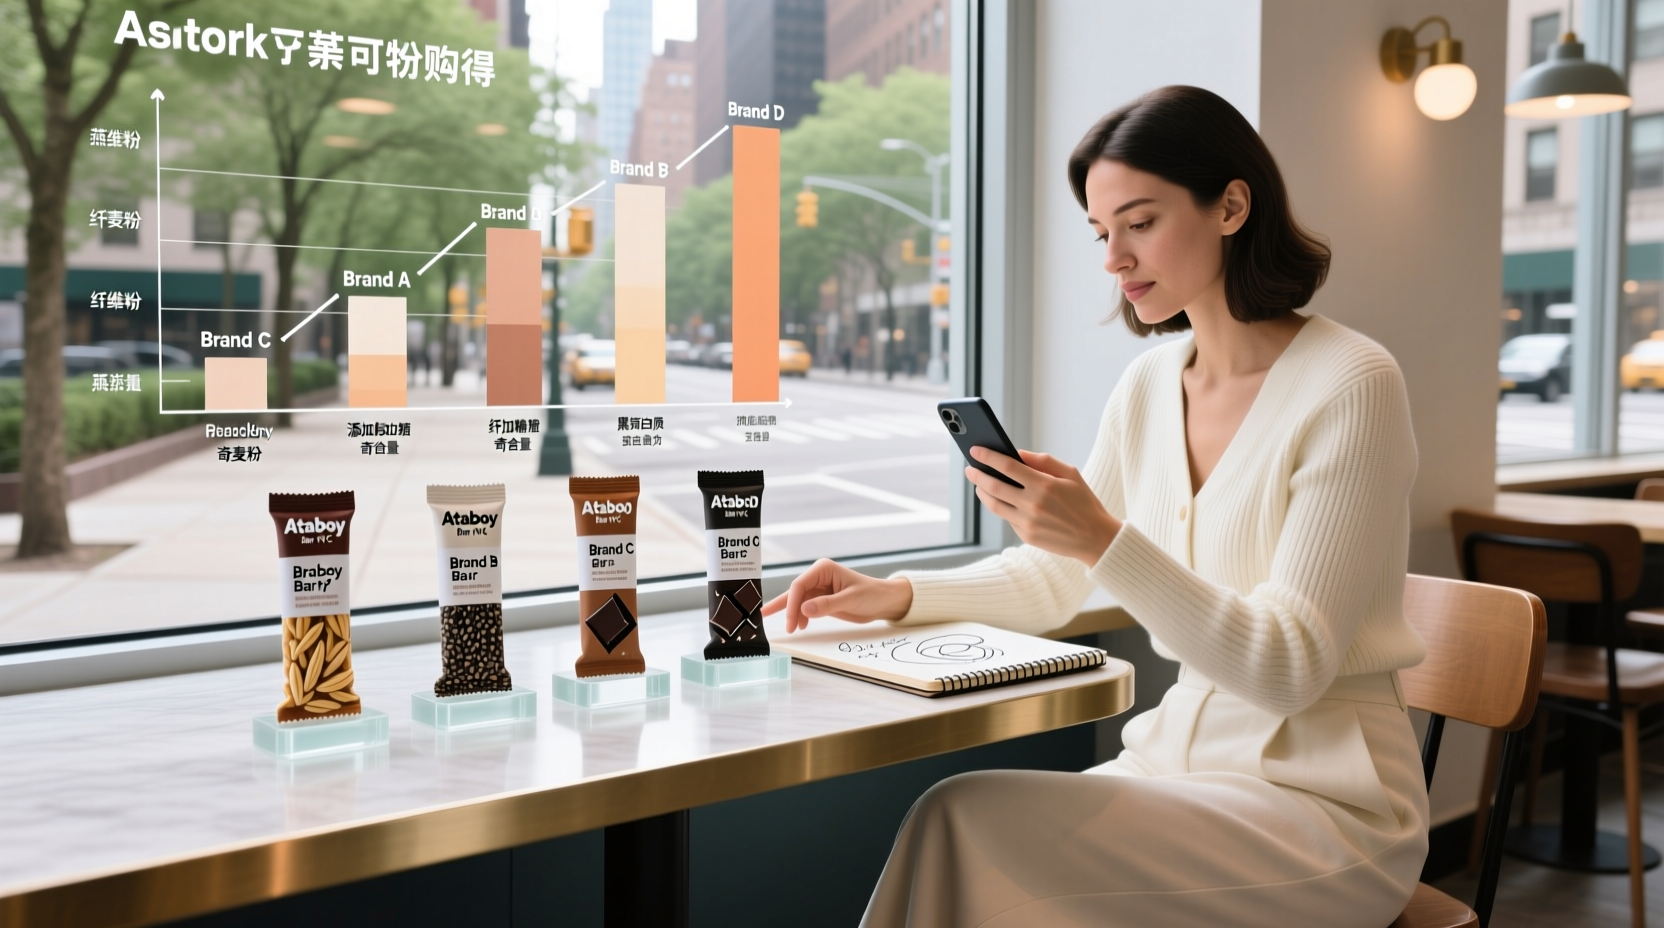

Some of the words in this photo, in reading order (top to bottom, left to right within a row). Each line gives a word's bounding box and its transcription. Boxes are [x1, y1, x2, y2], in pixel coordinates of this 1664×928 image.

[284, 516, 346, 537] Ataboy
[441, 510, 498, 529] Ataboy
[589, 542, 623, 556] Brand
[625, 542, 635, 555] C
[718, 535, 750, 548] Brand
[450, 554, 487, 570] Brand
[489, 554, 499, 568] B
[293, 563, 343, 580] Braboy
